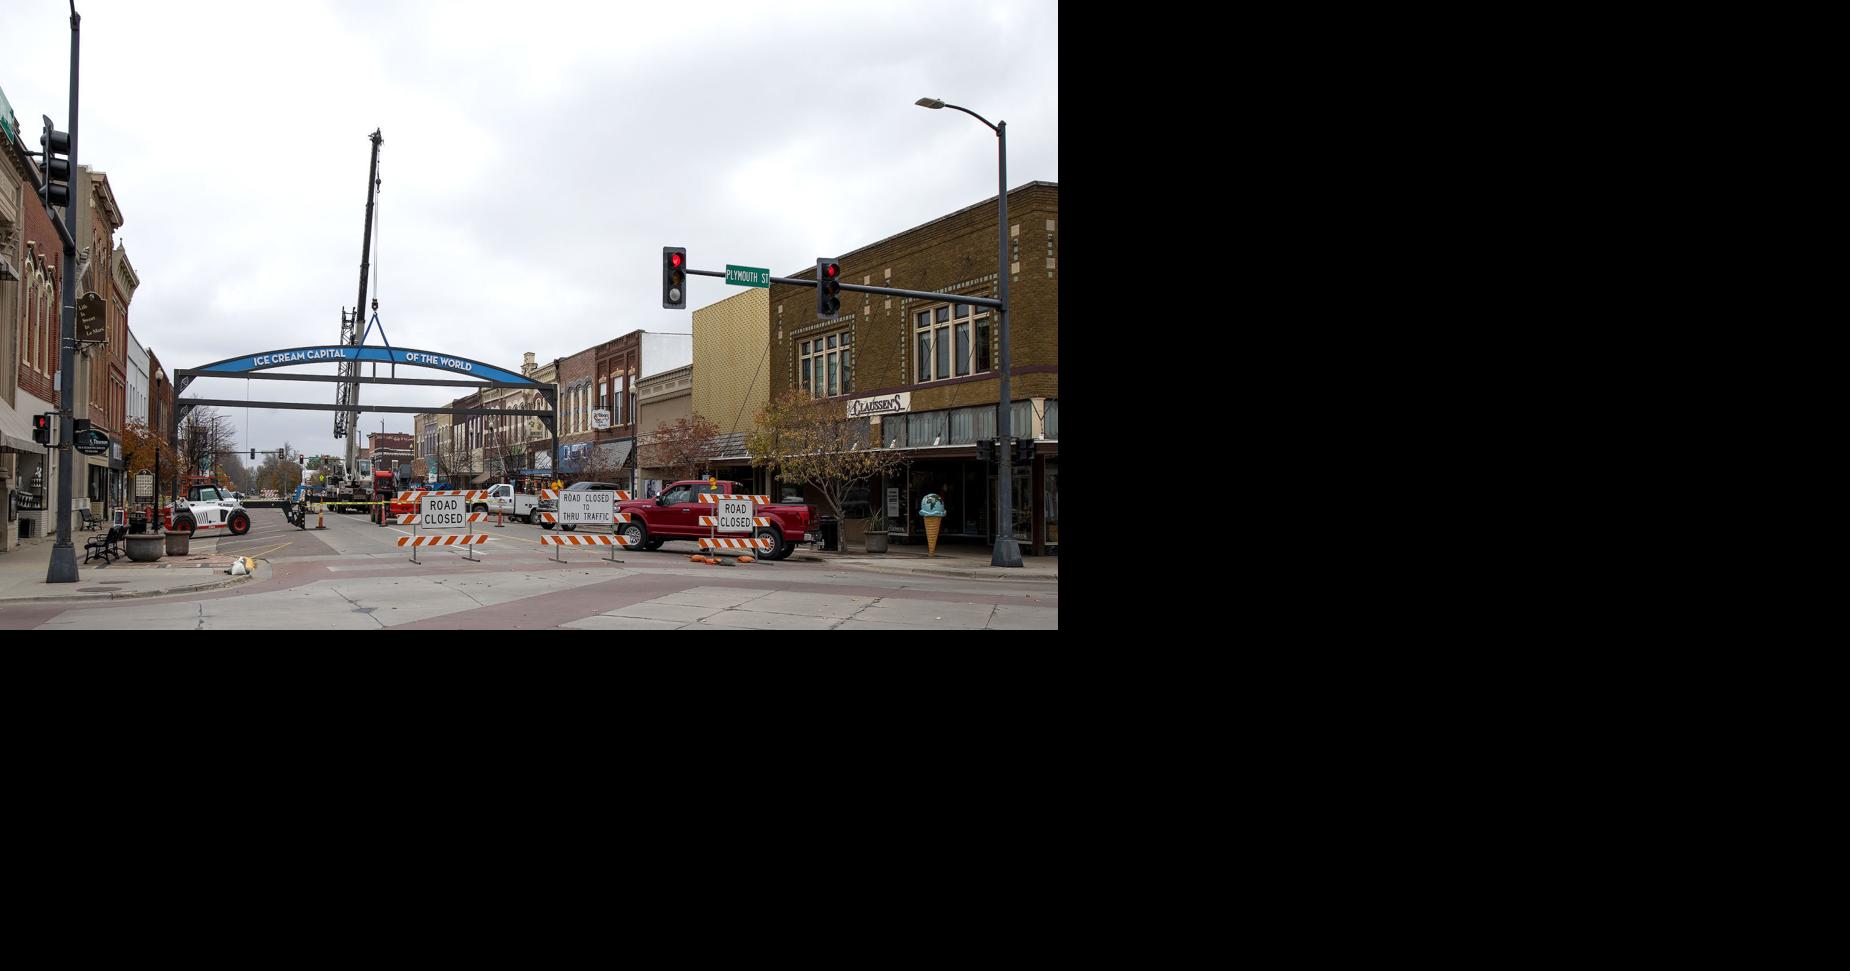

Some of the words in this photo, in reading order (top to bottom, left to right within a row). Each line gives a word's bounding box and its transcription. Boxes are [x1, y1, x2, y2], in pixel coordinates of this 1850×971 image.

[726, 269, 758, 283] PLYMOUTH
[761, 272, 769, 284] ST
[253, 356, 271, 366] ICE
[271, 351, 305, 363] CREAM
[307, 349, 346, 359] CAPITAL
[406, 352, 419, 361] OF
[420, 354, 438, 364] THE
[440, 357, 472, 371] WORLD
[853, 394, 901, 416] CLAUSSEN'S
[563, 494, 581, 502] ROAD
[585, 495, 610, 503] CLOSED
[430, 500, 457, 510] ROAD
[725, 503, 747, 514] ROAD
[424, 513, 463, 524] CLOSED
[563, 512, 580, 521] THRU
[584, 512, 610, 521] TRAFFIC
[720, 517, 751, 527] CLOSED
